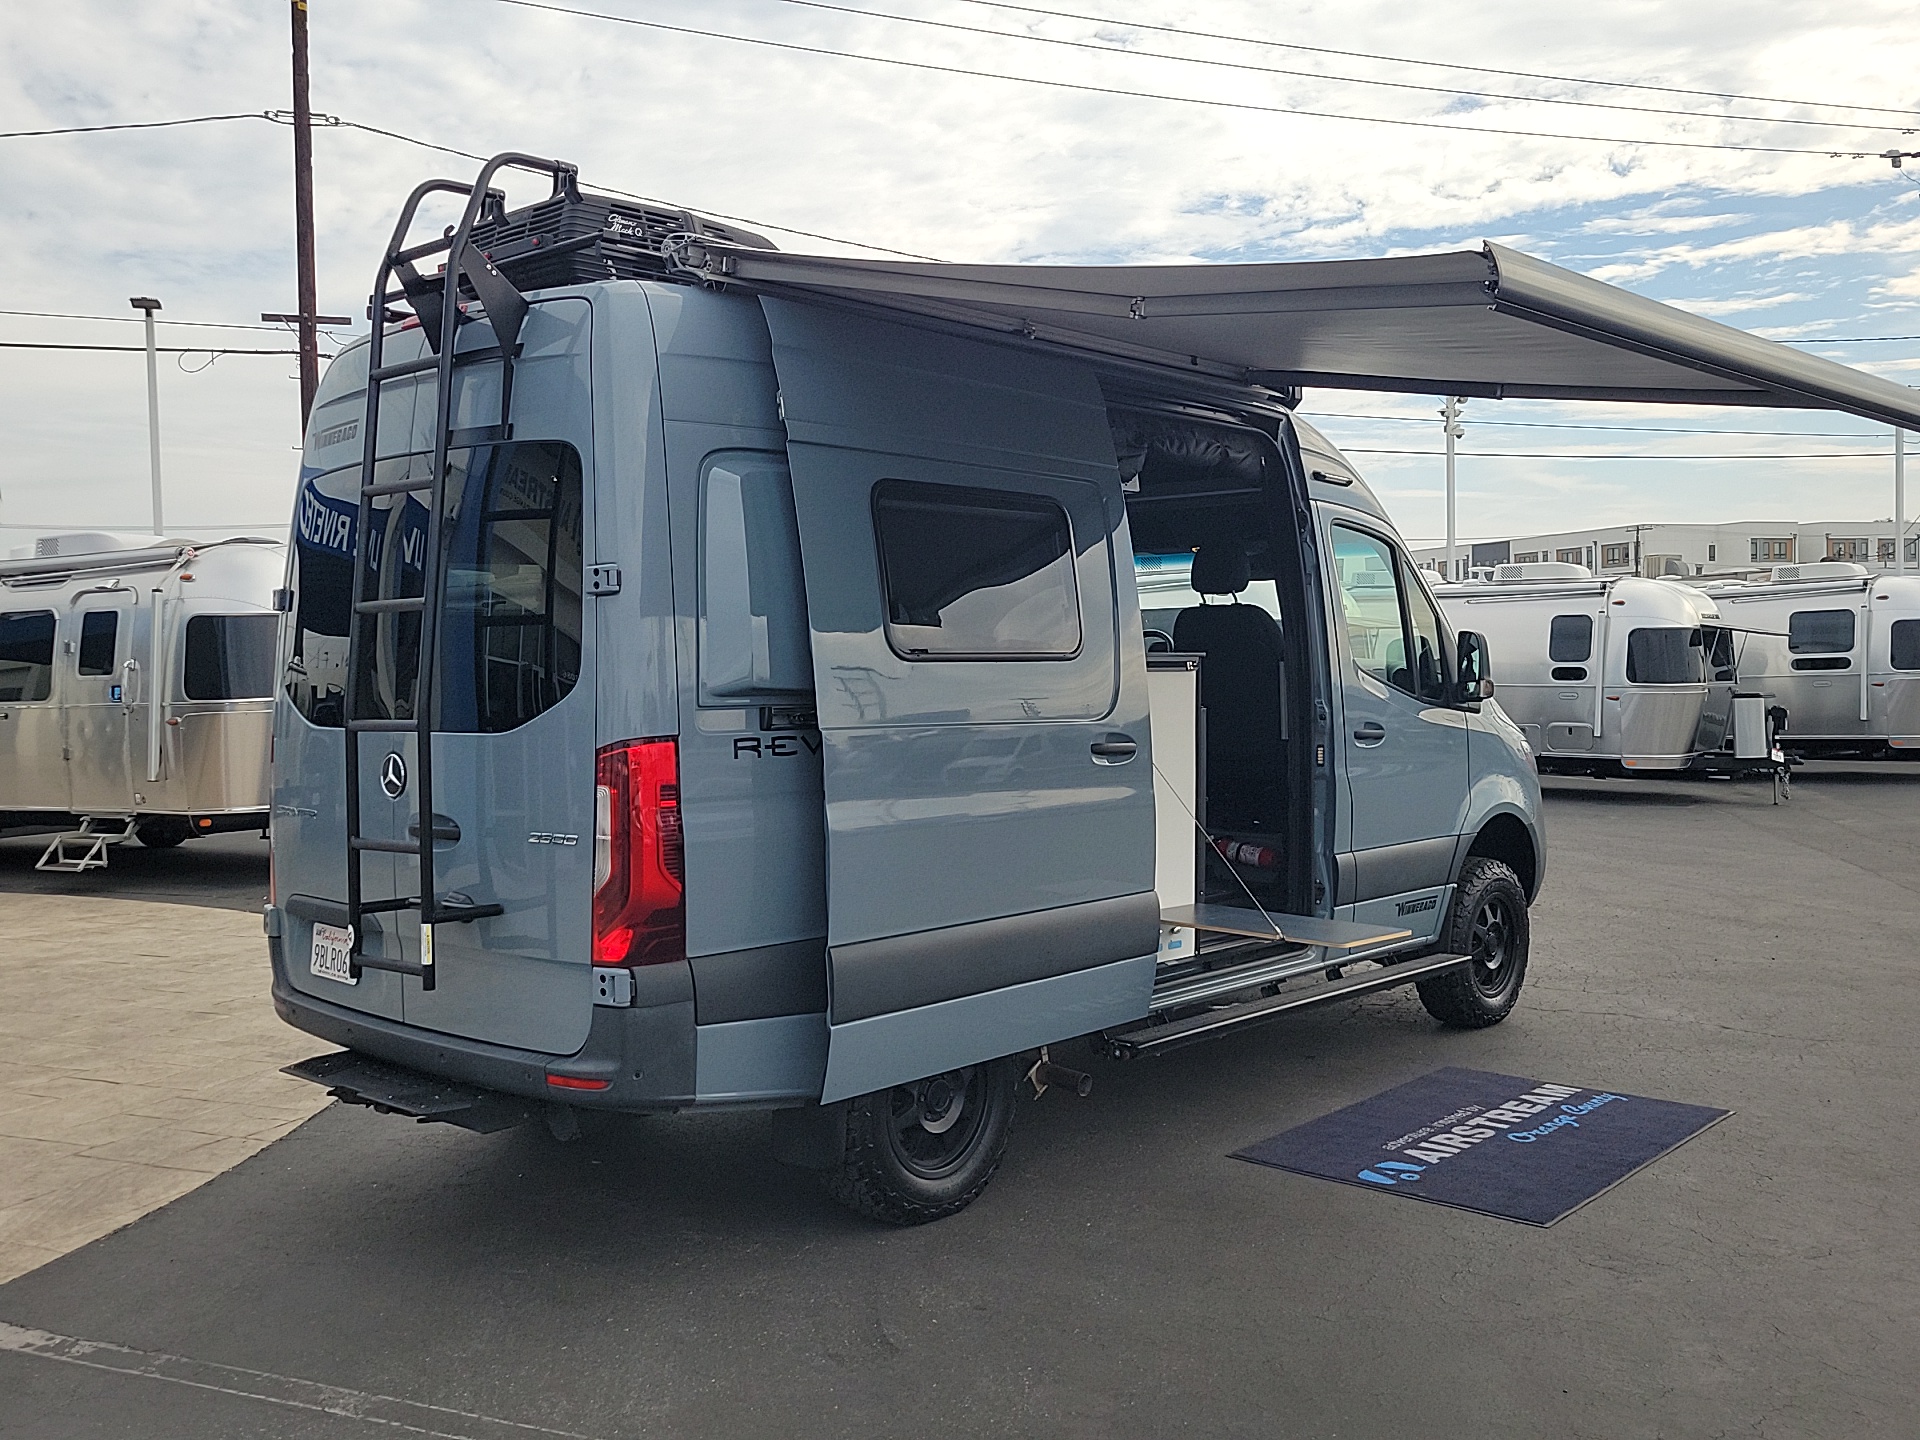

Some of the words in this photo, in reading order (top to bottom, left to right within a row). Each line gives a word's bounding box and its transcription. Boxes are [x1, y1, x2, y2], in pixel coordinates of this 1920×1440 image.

[313, 943, 351, 974] 9BLR06
[1403, 1083, 1583, 1164] AIRSTREAM
[1507, 1114, 1580, 1142] Orange
[1560, 1092, 1629, 1115] County
